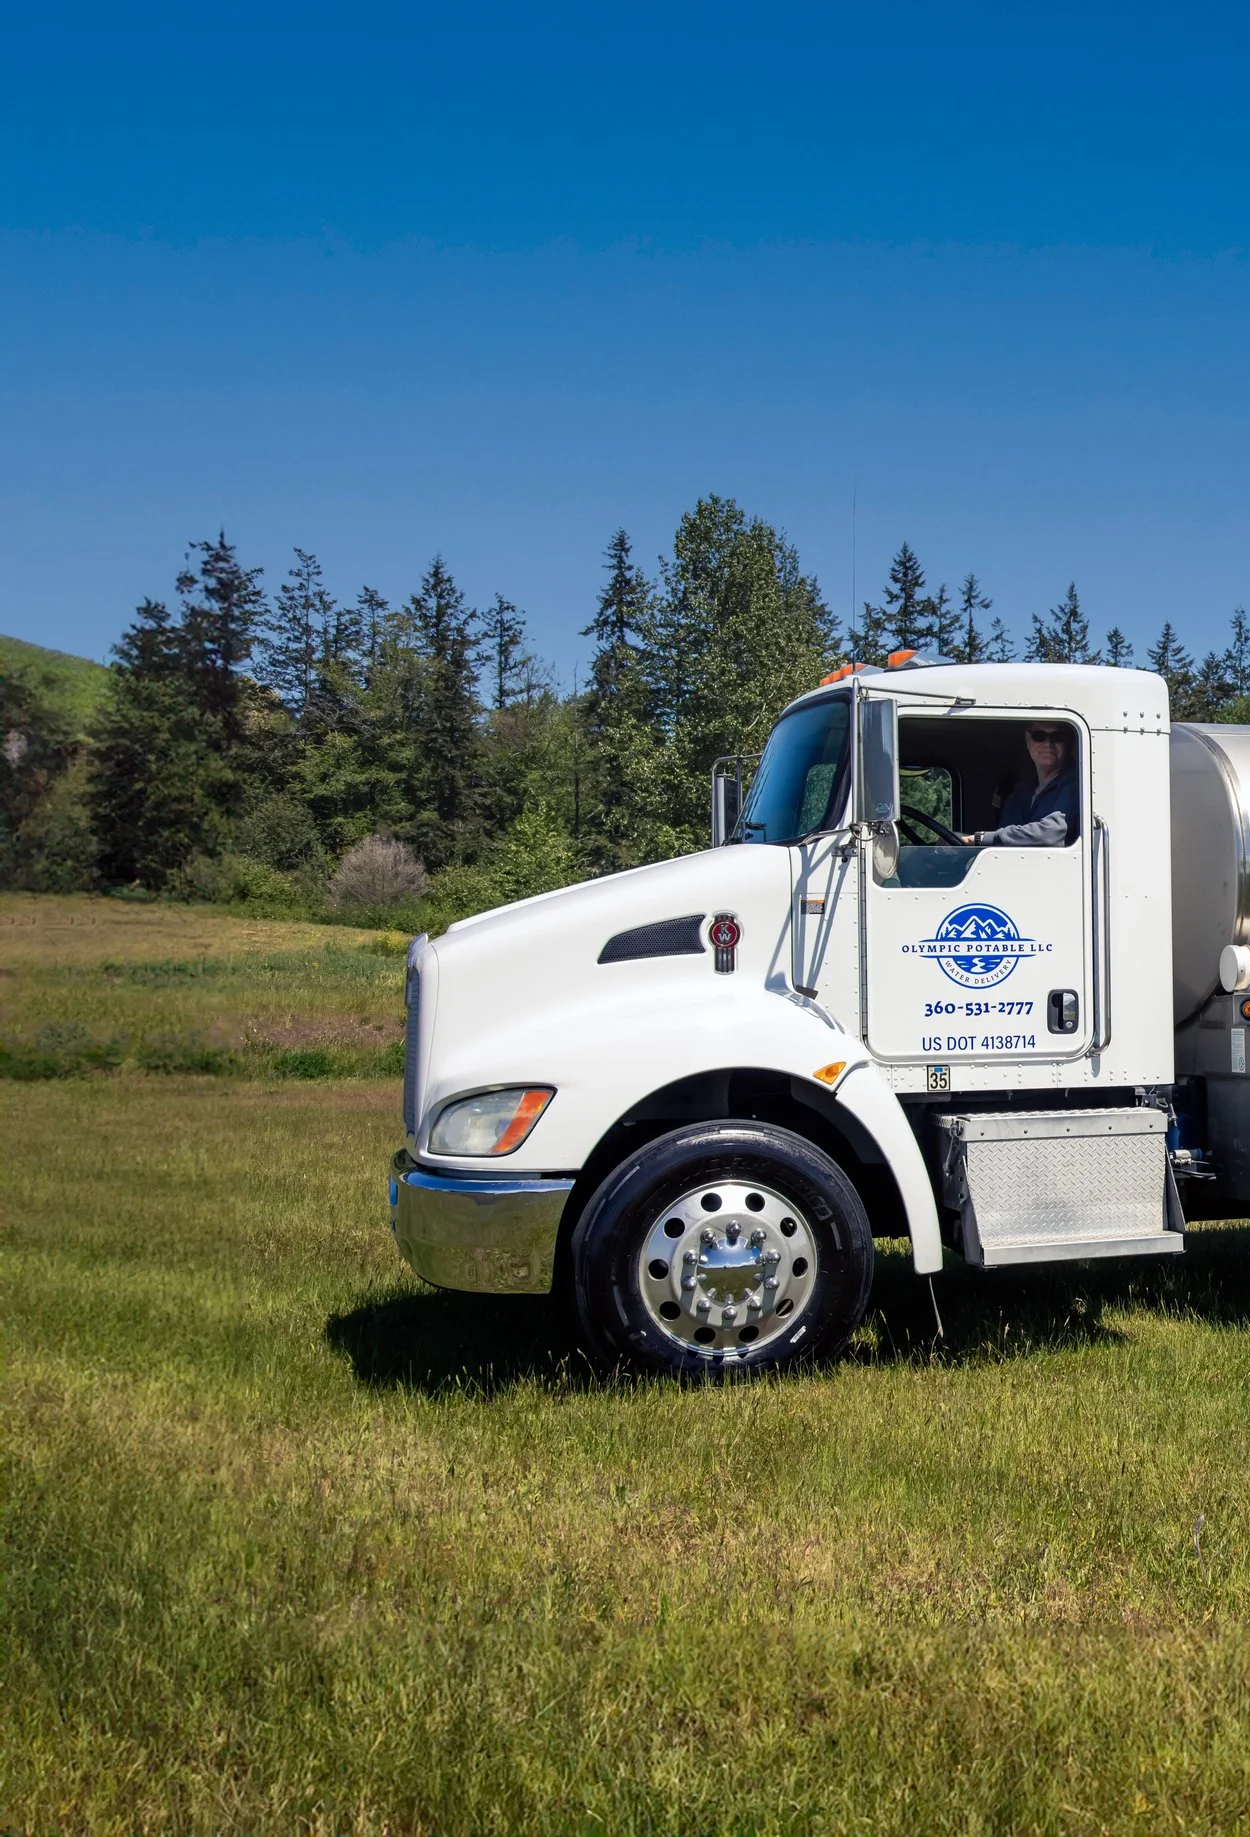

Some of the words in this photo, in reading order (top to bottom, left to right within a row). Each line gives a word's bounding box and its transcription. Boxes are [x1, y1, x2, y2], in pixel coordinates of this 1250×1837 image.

[901, 944, 961, 953] OLYMPIC
[966, 944, 1025, 953] POTABLE
[1030, 943, 1053, 952] LLC
[944, 960, 970, 984] WATER
[974, 958, 1012, 984] DELIVERY
[924, 1001, 1034, 1017] 360-531-2777
[922, 1037, 942, 1051] US
[947, 1036, 977, 1051] DOT
[981, 1035, 1036, 1050] 4138714
[930, 1072, 947, 1089] 35
